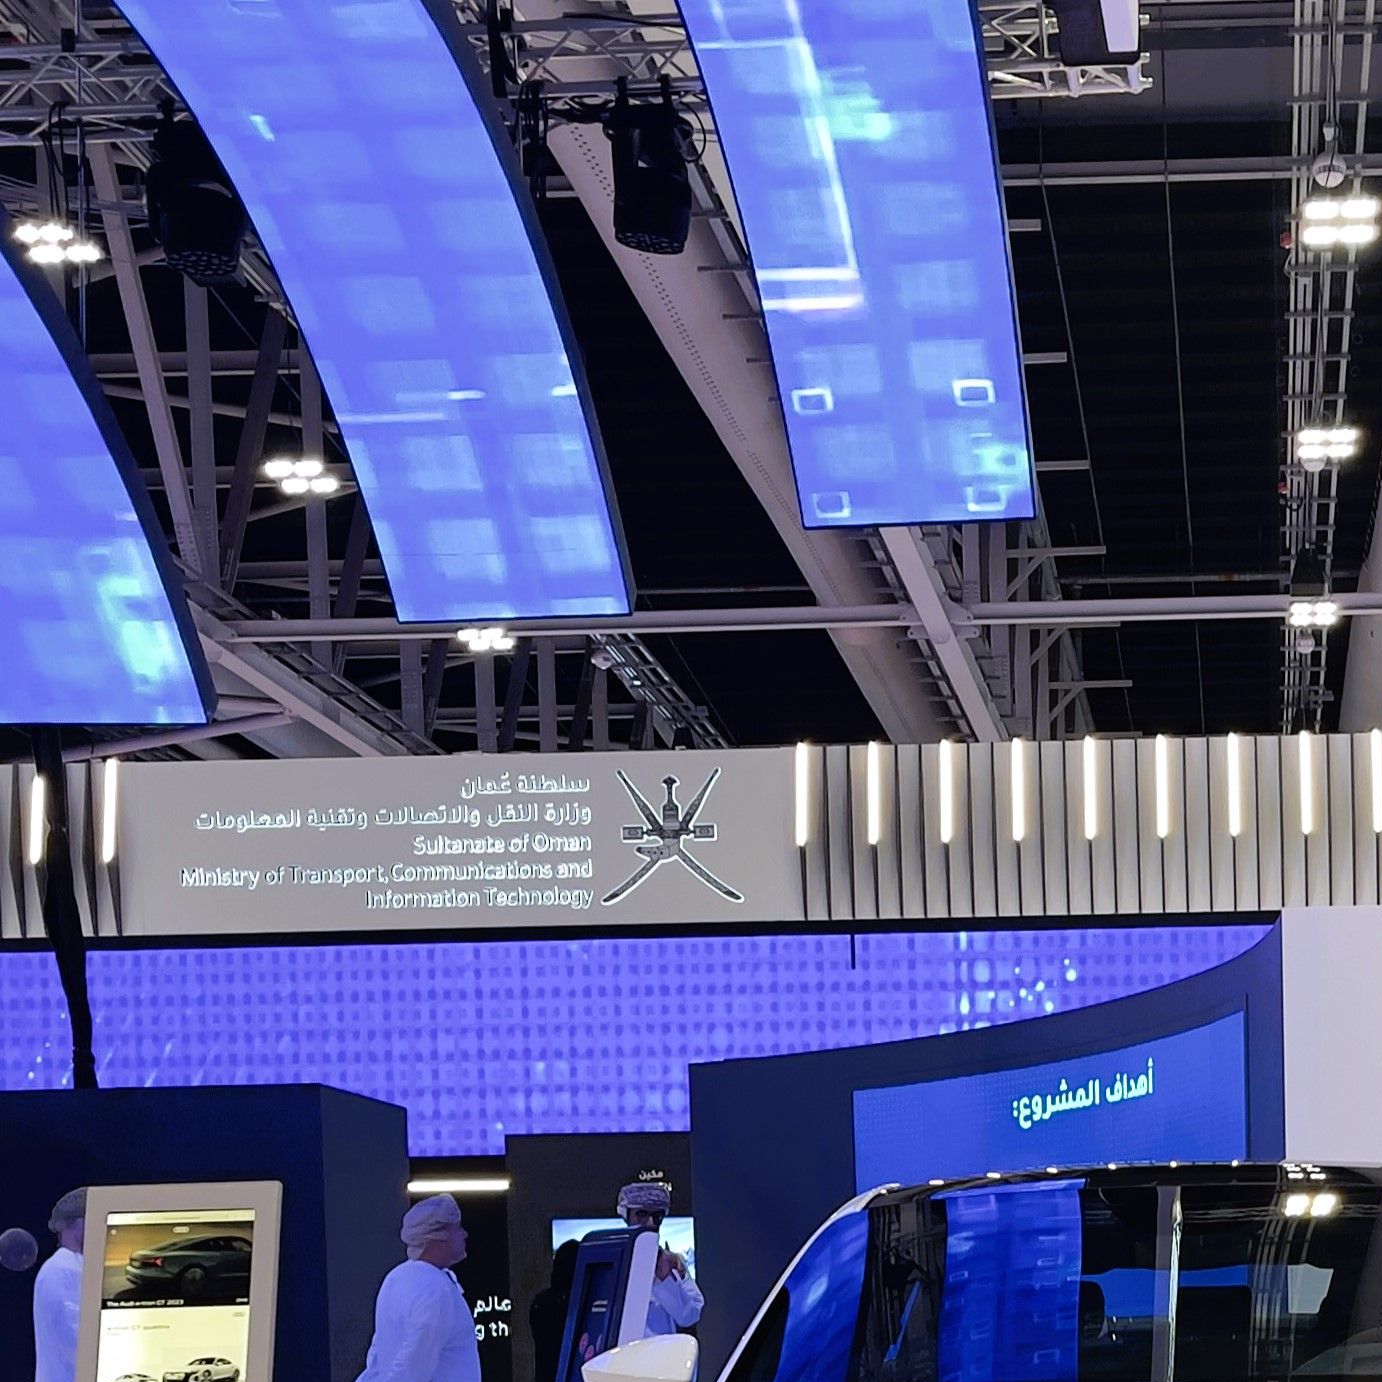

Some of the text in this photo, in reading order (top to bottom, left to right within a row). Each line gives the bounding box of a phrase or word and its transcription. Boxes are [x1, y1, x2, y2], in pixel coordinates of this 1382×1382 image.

[516, 774, 590, 794] سلطنة
[194, 801, 592, 834] وزارة النقل والاتصالات وتقنية المعلومات
[413, 832, 592, 855] Sultanate of Oman
[180, 859, 593, 890] Ministry of Transport, Communications and
[366, 886, 594, 909] Information Technology
[1012, 1056, 1154, 1130] أهداف المشروع:
